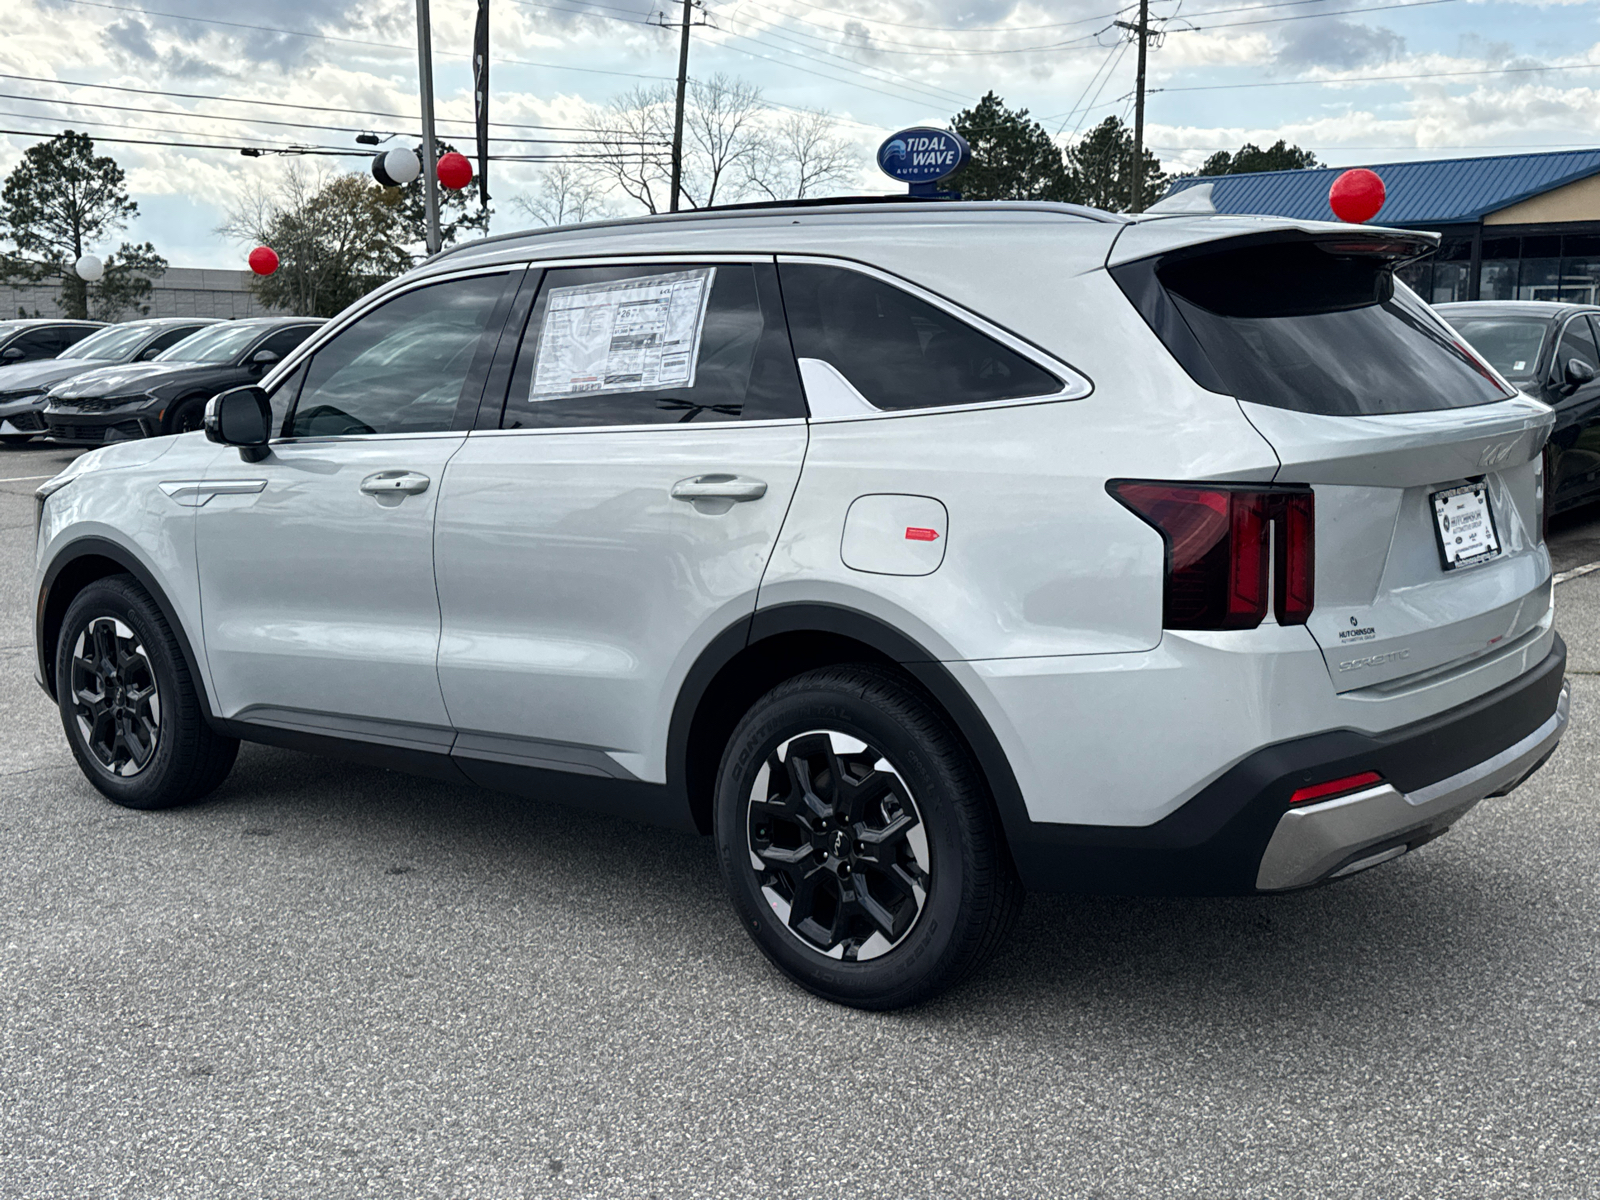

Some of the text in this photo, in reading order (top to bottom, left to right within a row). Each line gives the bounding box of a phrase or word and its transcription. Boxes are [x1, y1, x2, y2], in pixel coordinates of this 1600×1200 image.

[907, 137, 947, 151] TIDAL
[913, 151, 955, 166] WAVE
[621, 310, 631, 318] 26
[1450, 511, 1482, 526] HUTCHINSON
[1453, 520, 1482, 534] AUTOMOTIVE GROUP
[1339, 627, 1376, 638] HUTCHINSON
[1341, 636, 1364, 644] AUTOMOTIVE
[731, 705, 853, 783] CONTINENTAL
